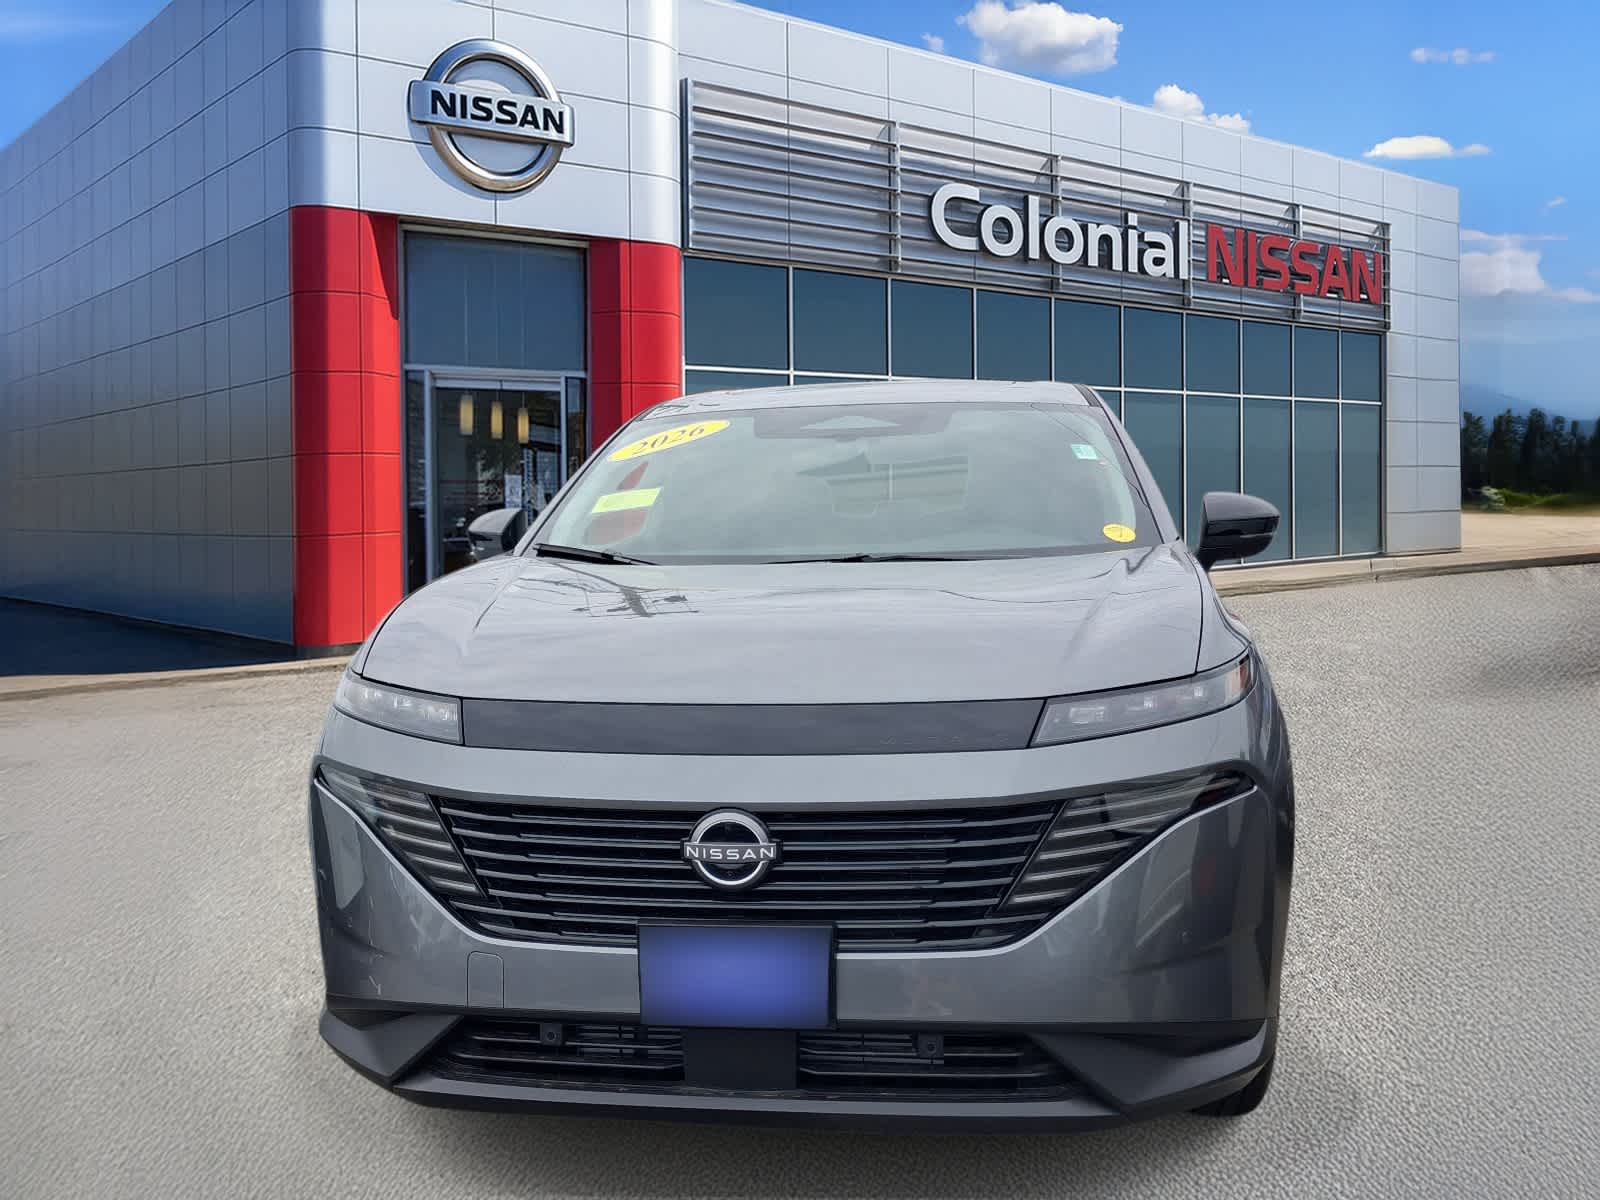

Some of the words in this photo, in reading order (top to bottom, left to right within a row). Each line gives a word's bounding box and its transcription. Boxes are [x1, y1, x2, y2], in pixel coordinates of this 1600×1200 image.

[430, 89, 564, 134] NISSAN
[930, 183, 1189, 280] Colonial
[1207, 223, 1382, 305] NISSAN
[631, 427, 705, 455] 2026
[686, 845, 774, 860] NISSAN
